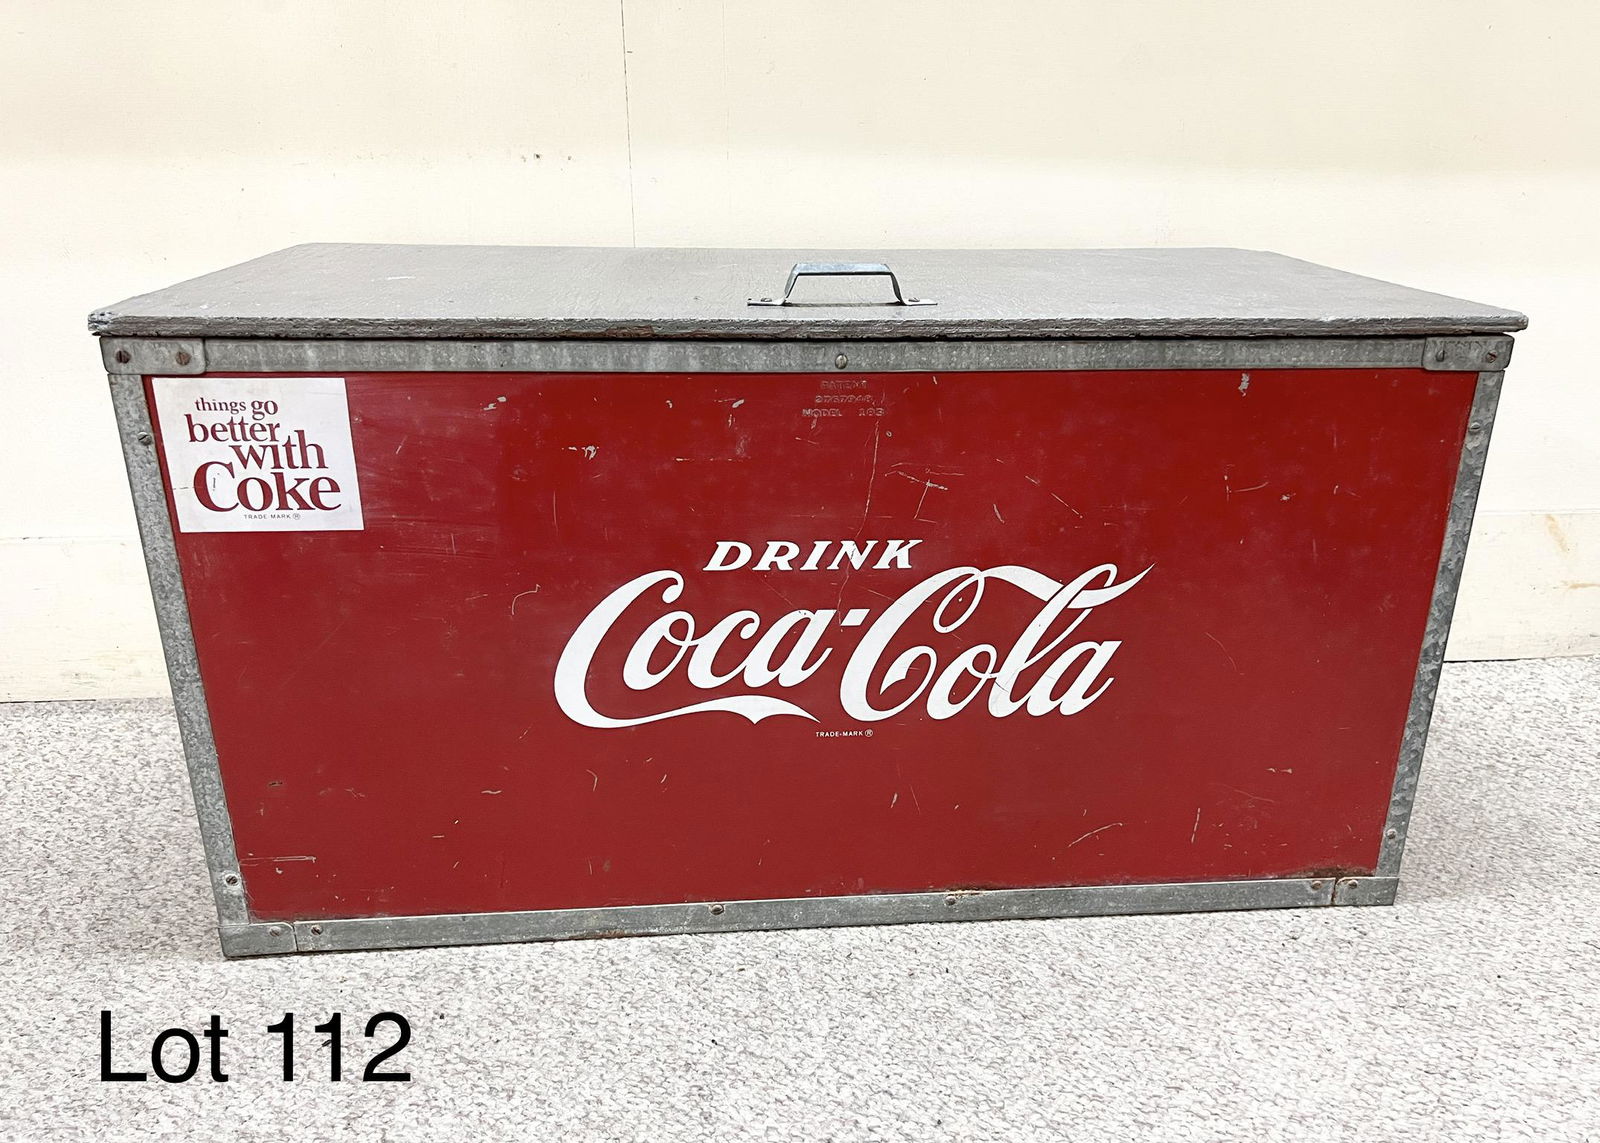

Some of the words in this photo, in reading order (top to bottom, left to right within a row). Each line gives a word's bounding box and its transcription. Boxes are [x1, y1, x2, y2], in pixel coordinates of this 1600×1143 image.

[195, 397, 247, 414] things
[251, 400, 279, 420] go
[802, 408, 843, 417] MODEL
[184, 414, 281, 443] better
[229, 429, 329, 470] with
[193, 460, 342, 512] Coke
[703, 539, 923, 572] DRINK
[553, 562, 1156, 728] Coca-Cola
